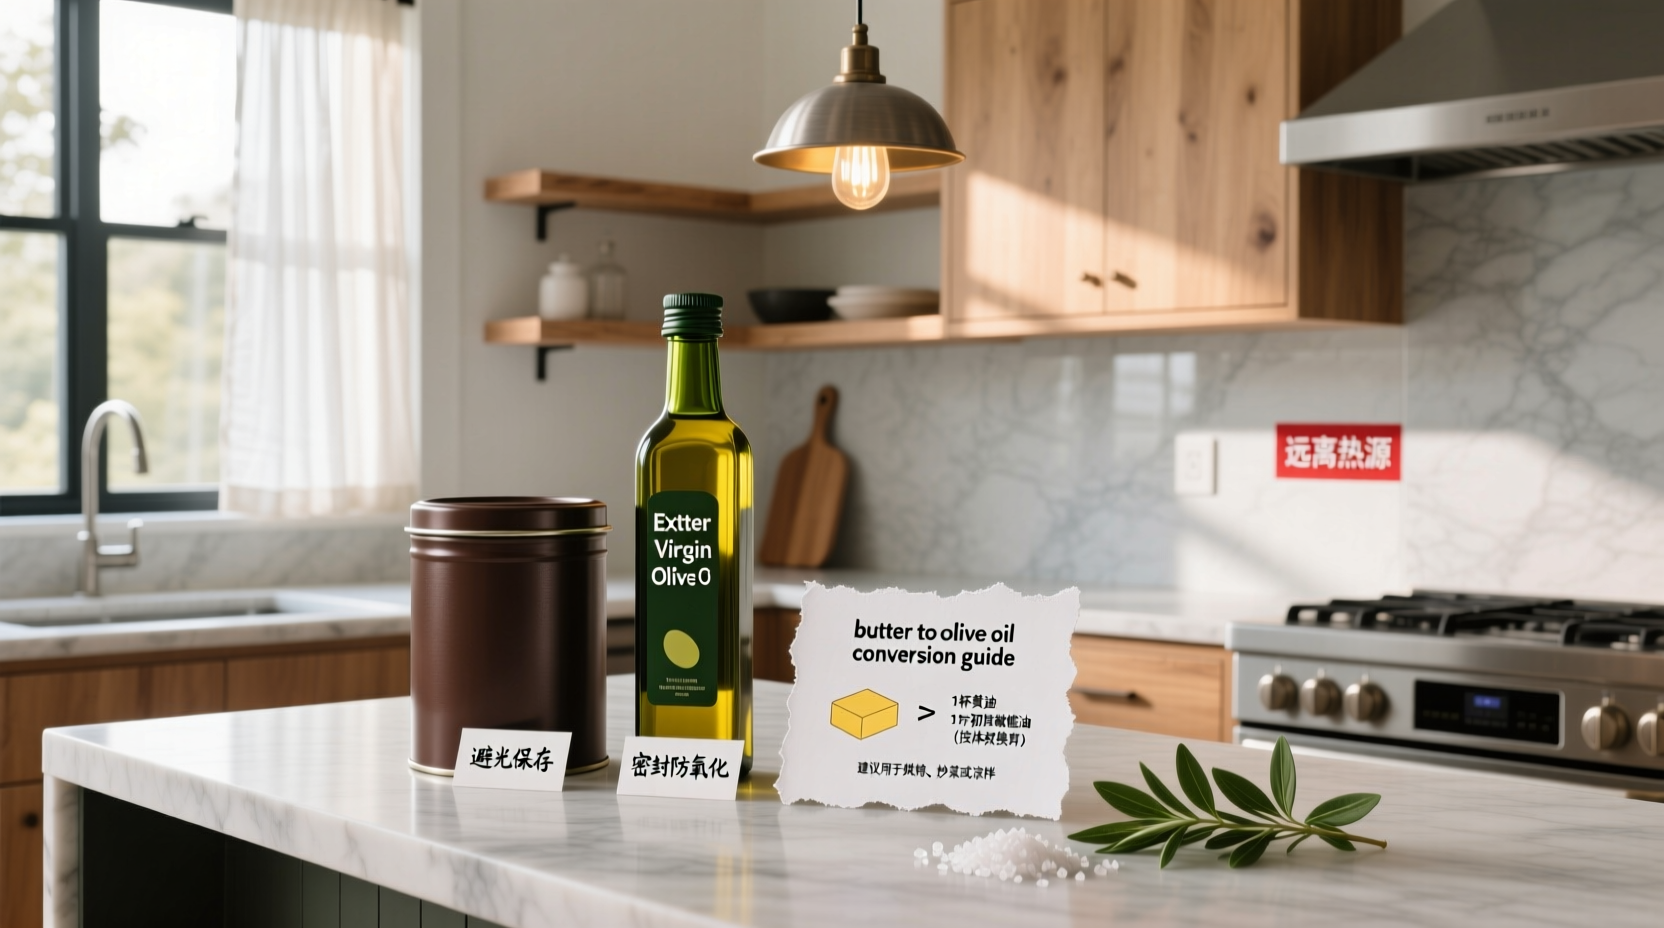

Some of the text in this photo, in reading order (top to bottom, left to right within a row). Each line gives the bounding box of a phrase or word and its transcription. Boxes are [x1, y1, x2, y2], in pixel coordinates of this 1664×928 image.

[653, 512, 712, 532] Extter
[653, 538, 712, 564] Virgin
[854, 618, 1015, 643] butter to olive oil
[852, 645, 1016, 671] conversion guide
[469, 745, 554, 773] 避光保存
[631, 751, 730, 780] 密封防氧化
